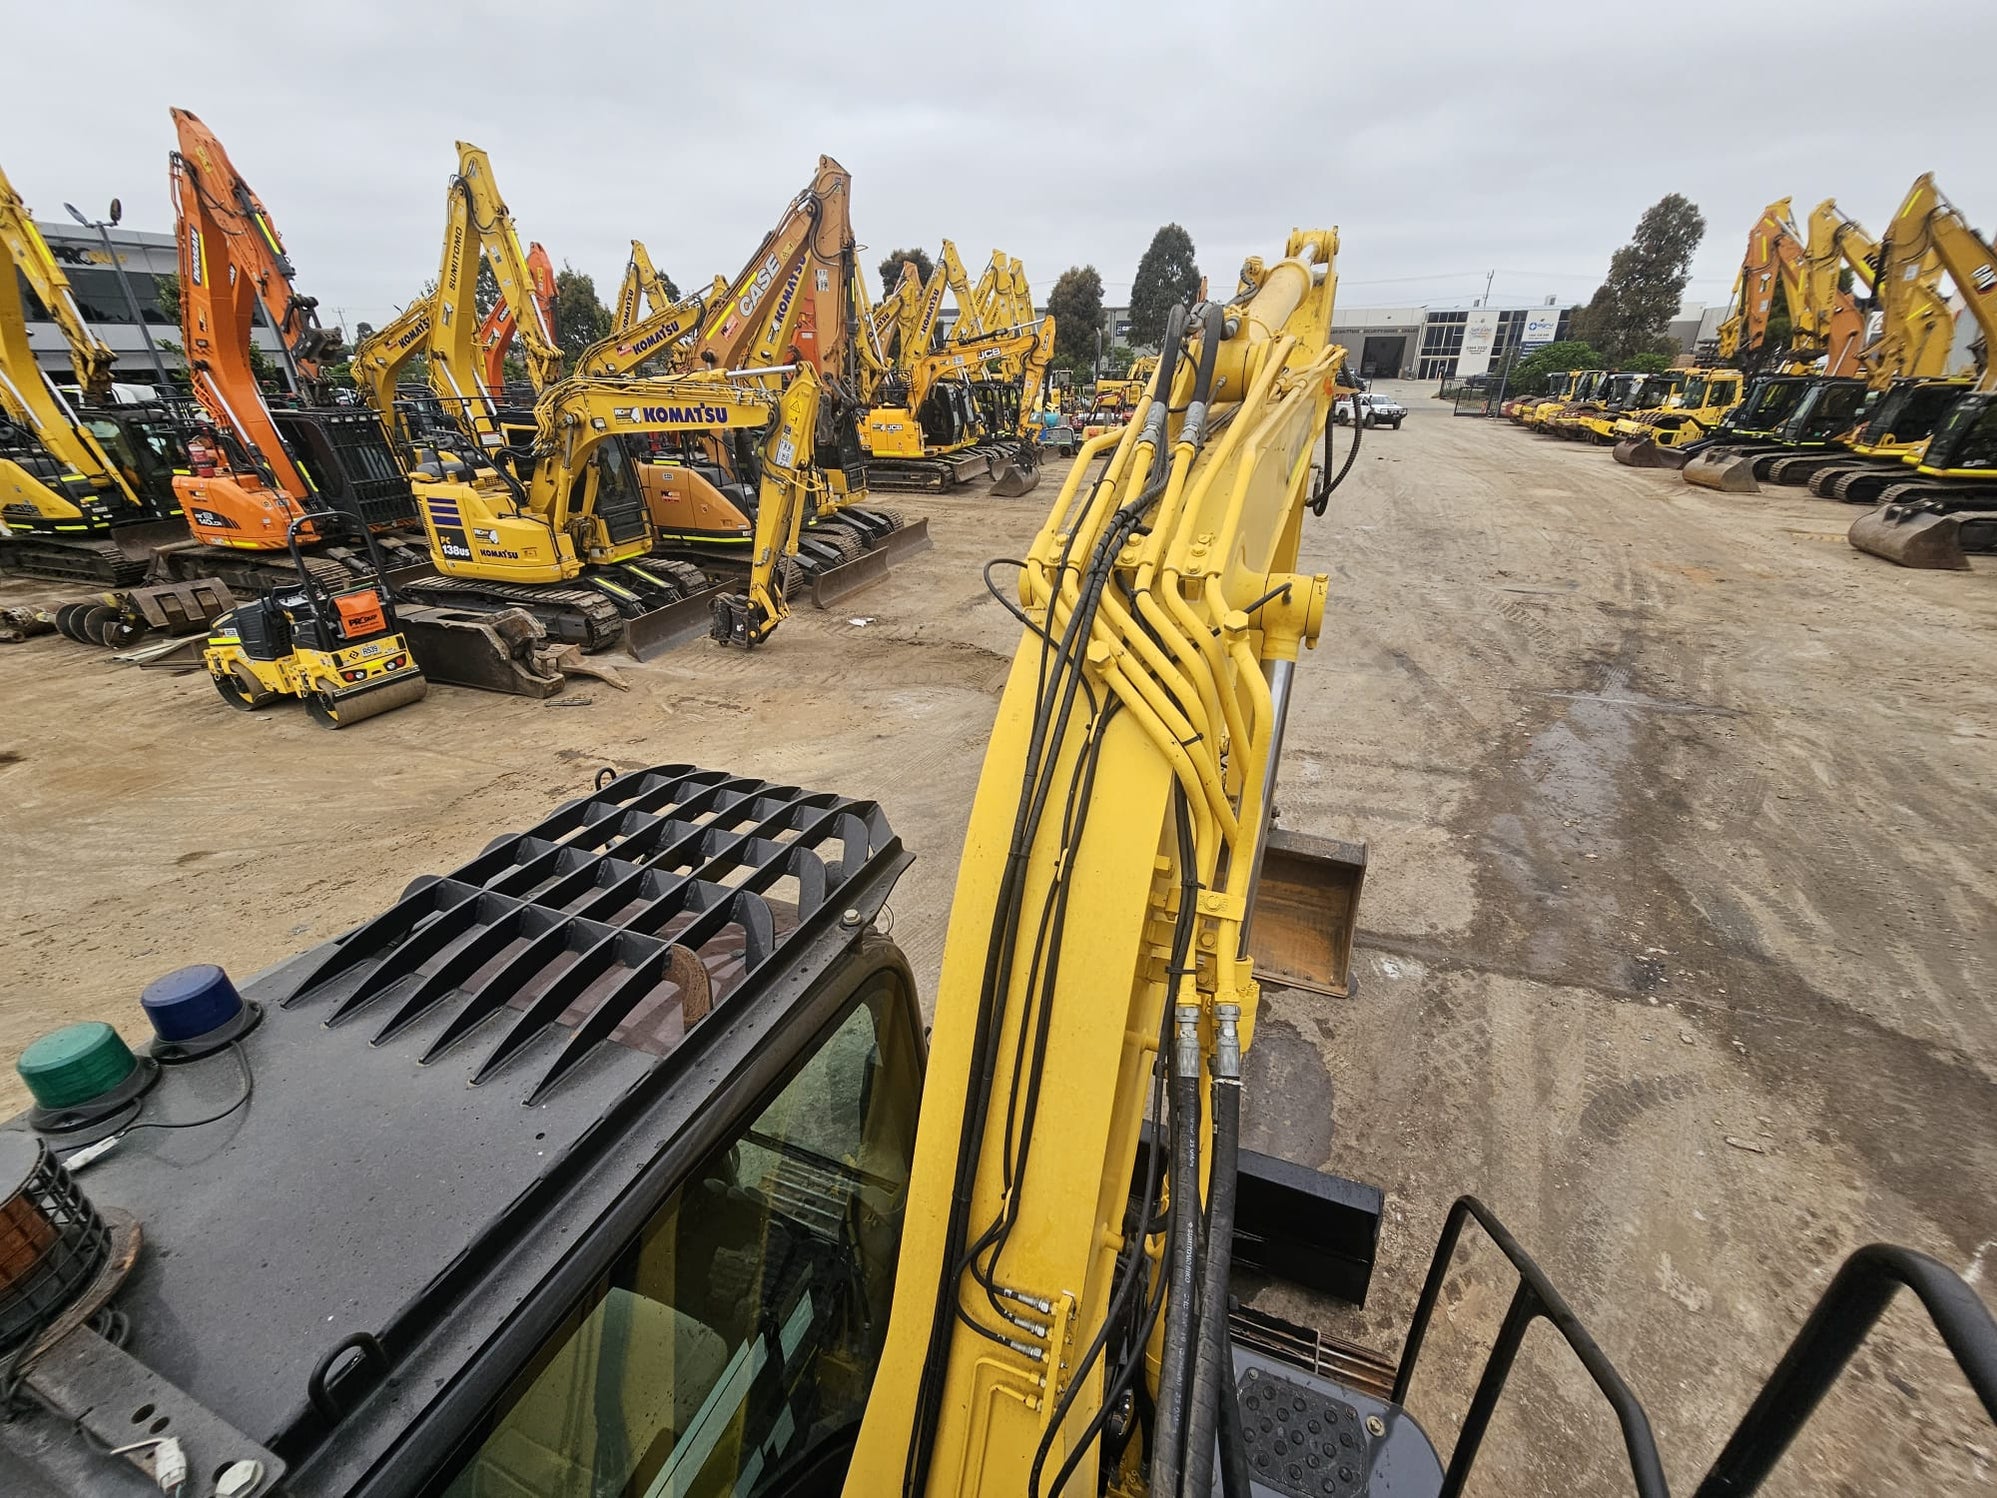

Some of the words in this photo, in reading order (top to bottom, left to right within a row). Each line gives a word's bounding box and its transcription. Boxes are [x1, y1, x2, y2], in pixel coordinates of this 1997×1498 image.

[448, 226, 463, 291] SUMITOMO
[739, 251, 781, 317] CASE
[921, 288, 940, 333] KOMATSU
[398, 317, 431, 349] KOMATS
[632, 320, 680, 355] KOMATSU
[978, 347, 1000, 360] JCB
[642, 402, 728, 424] KOMATSU
[440, 536, 451, 545] PC
[442, 544, 470, 557] 138US
[480, 549, 519, 559] KOMATSU
